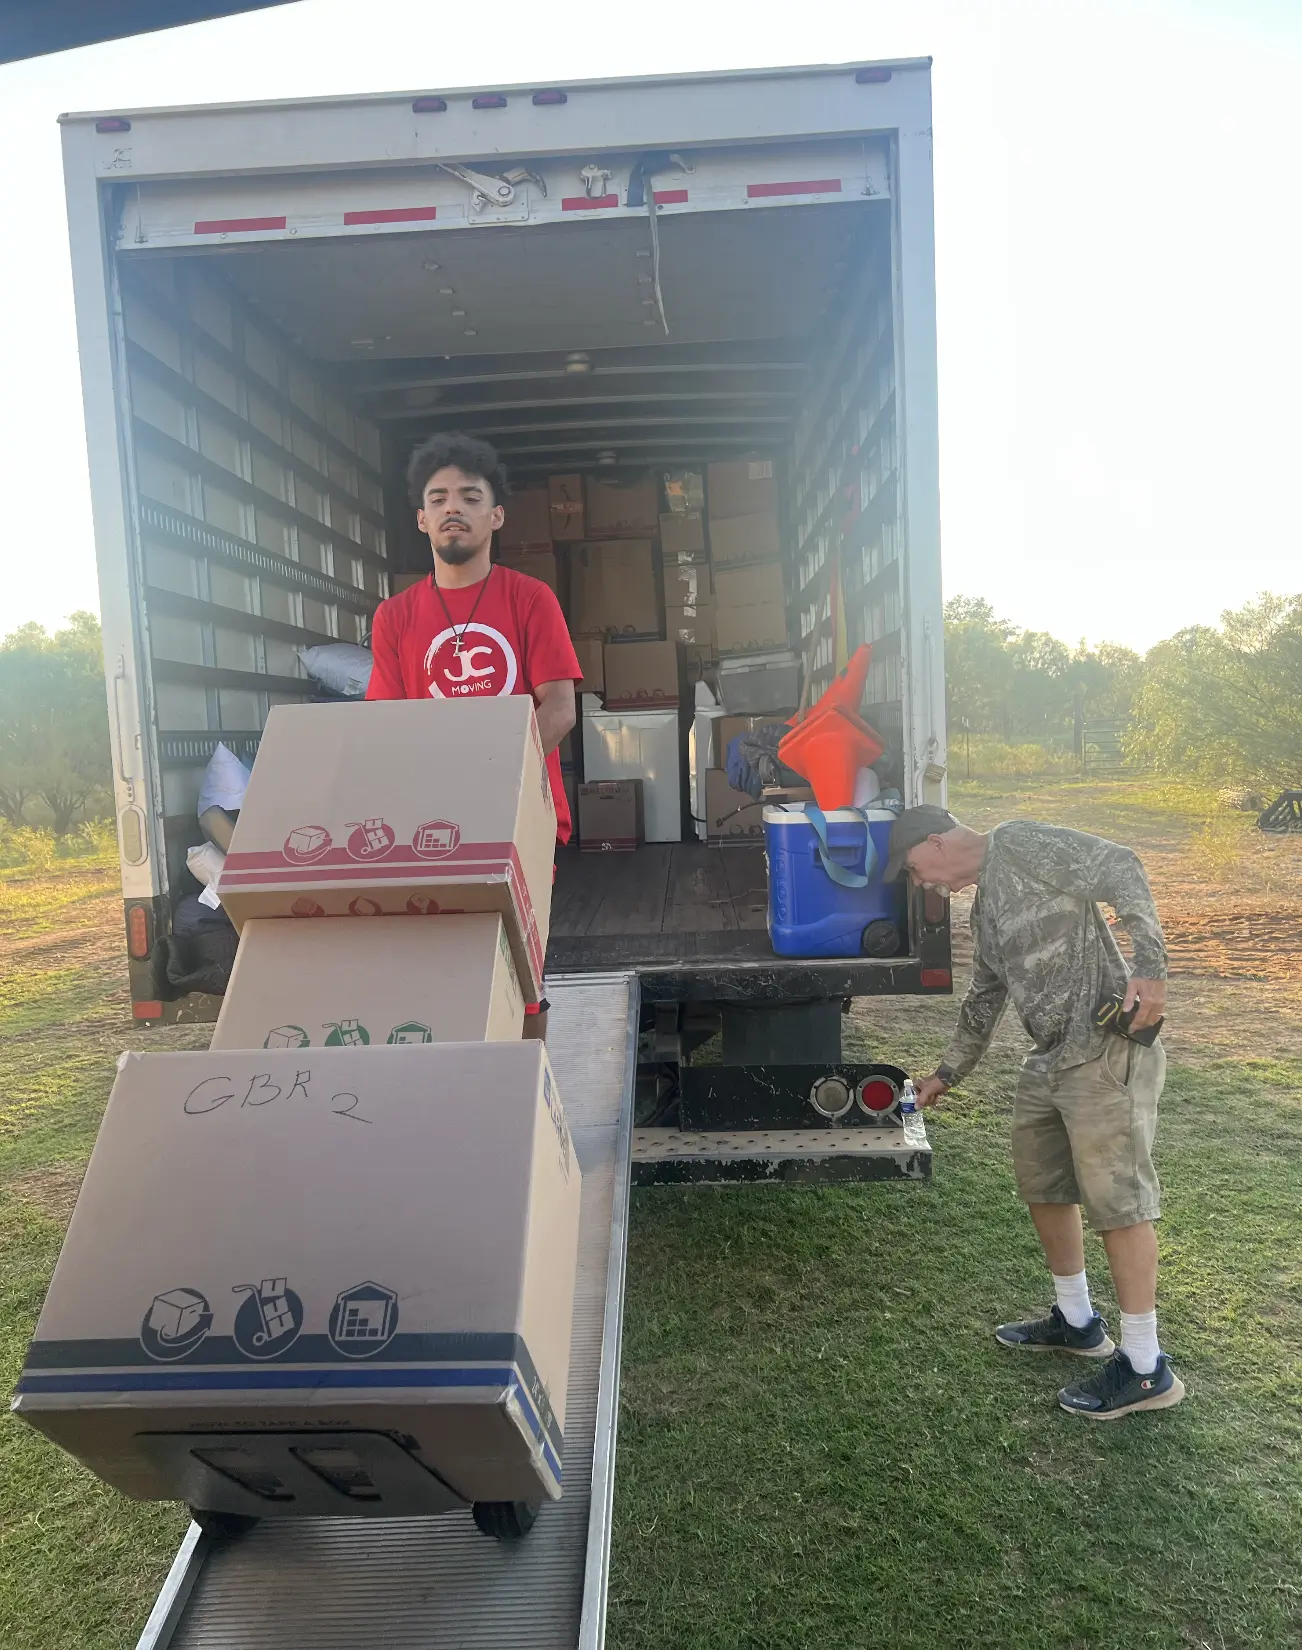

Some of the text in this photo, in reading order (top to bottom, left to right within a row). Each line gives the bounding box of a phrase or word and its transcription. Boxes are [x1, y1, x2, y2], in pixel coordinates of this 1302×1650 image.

[451, 679, 492, 696] MOVING
[183, 1069, 374, 1124] GBR 2
